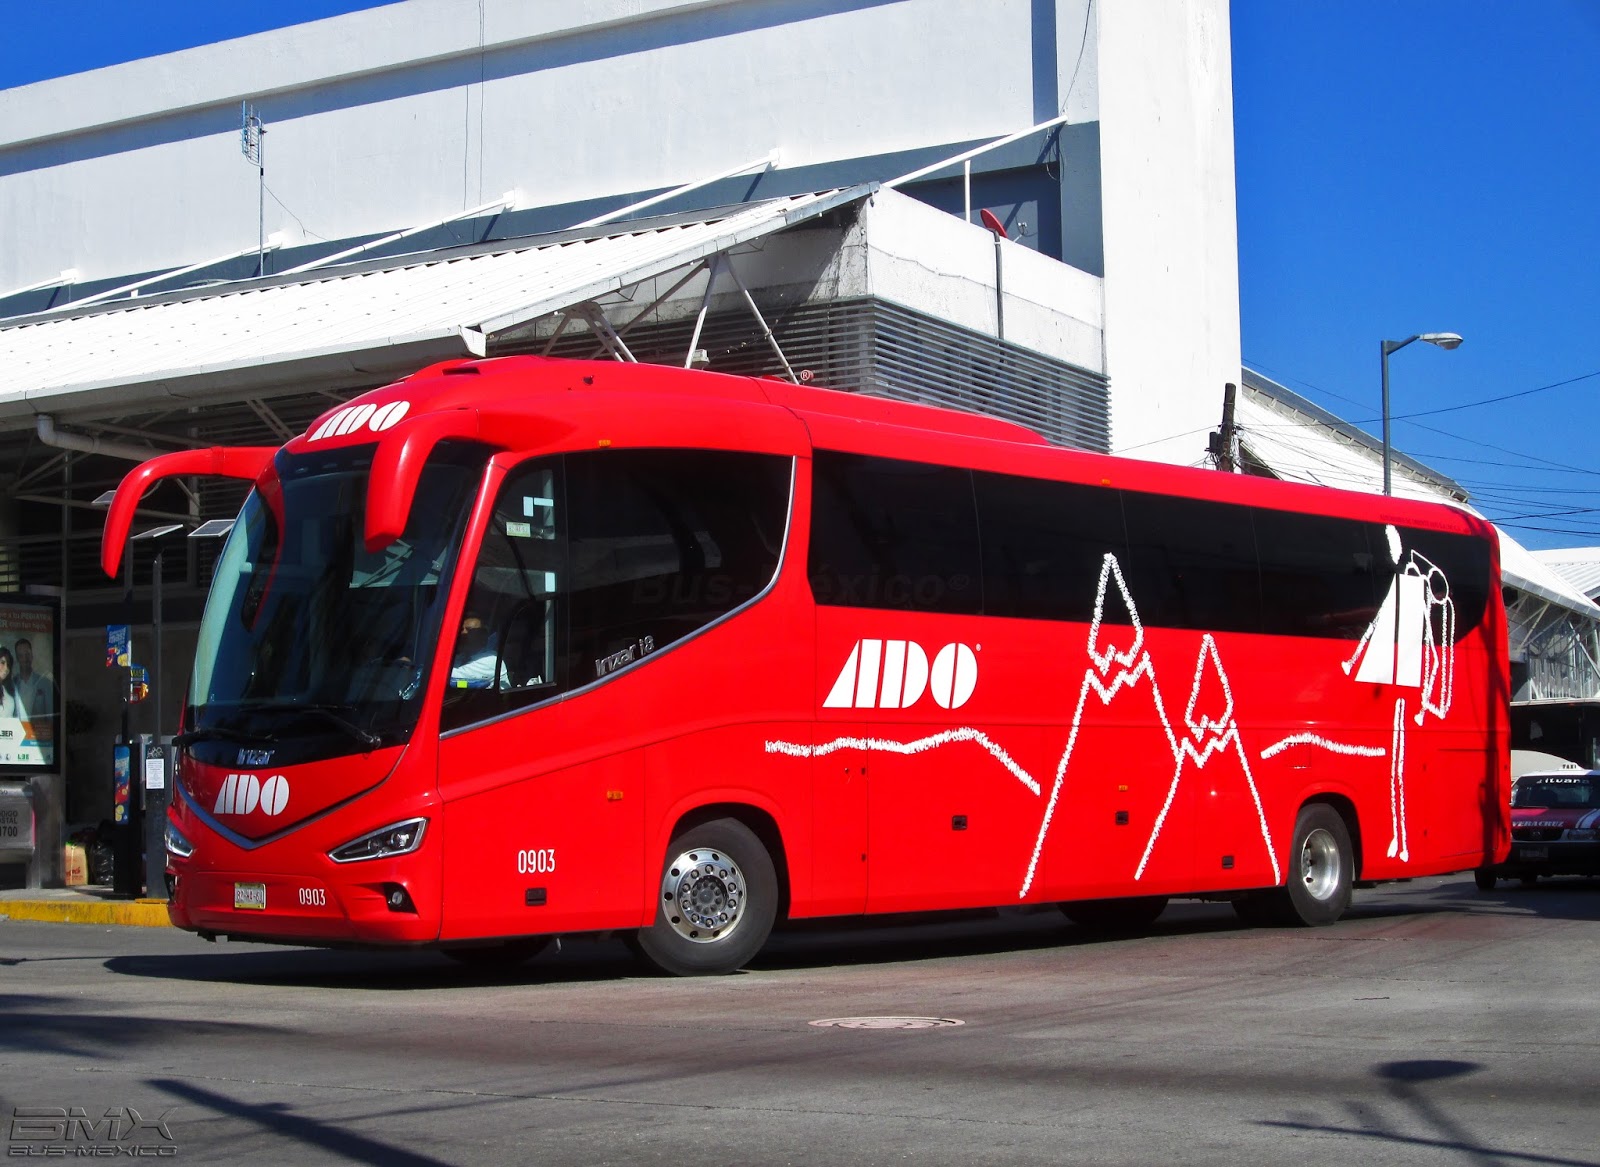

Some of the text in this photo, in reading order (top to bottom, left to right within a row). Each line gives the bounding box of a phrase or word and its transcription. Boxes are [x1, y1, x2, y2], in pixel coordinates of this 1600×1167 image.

[306, 400, 411, 442] ADO
[821, 638, 977, 710] ADO
[213, 774, 290, 816] ADO
[517, 848, 556, 874] 0903
[299, 887, 326, 906] 0903
